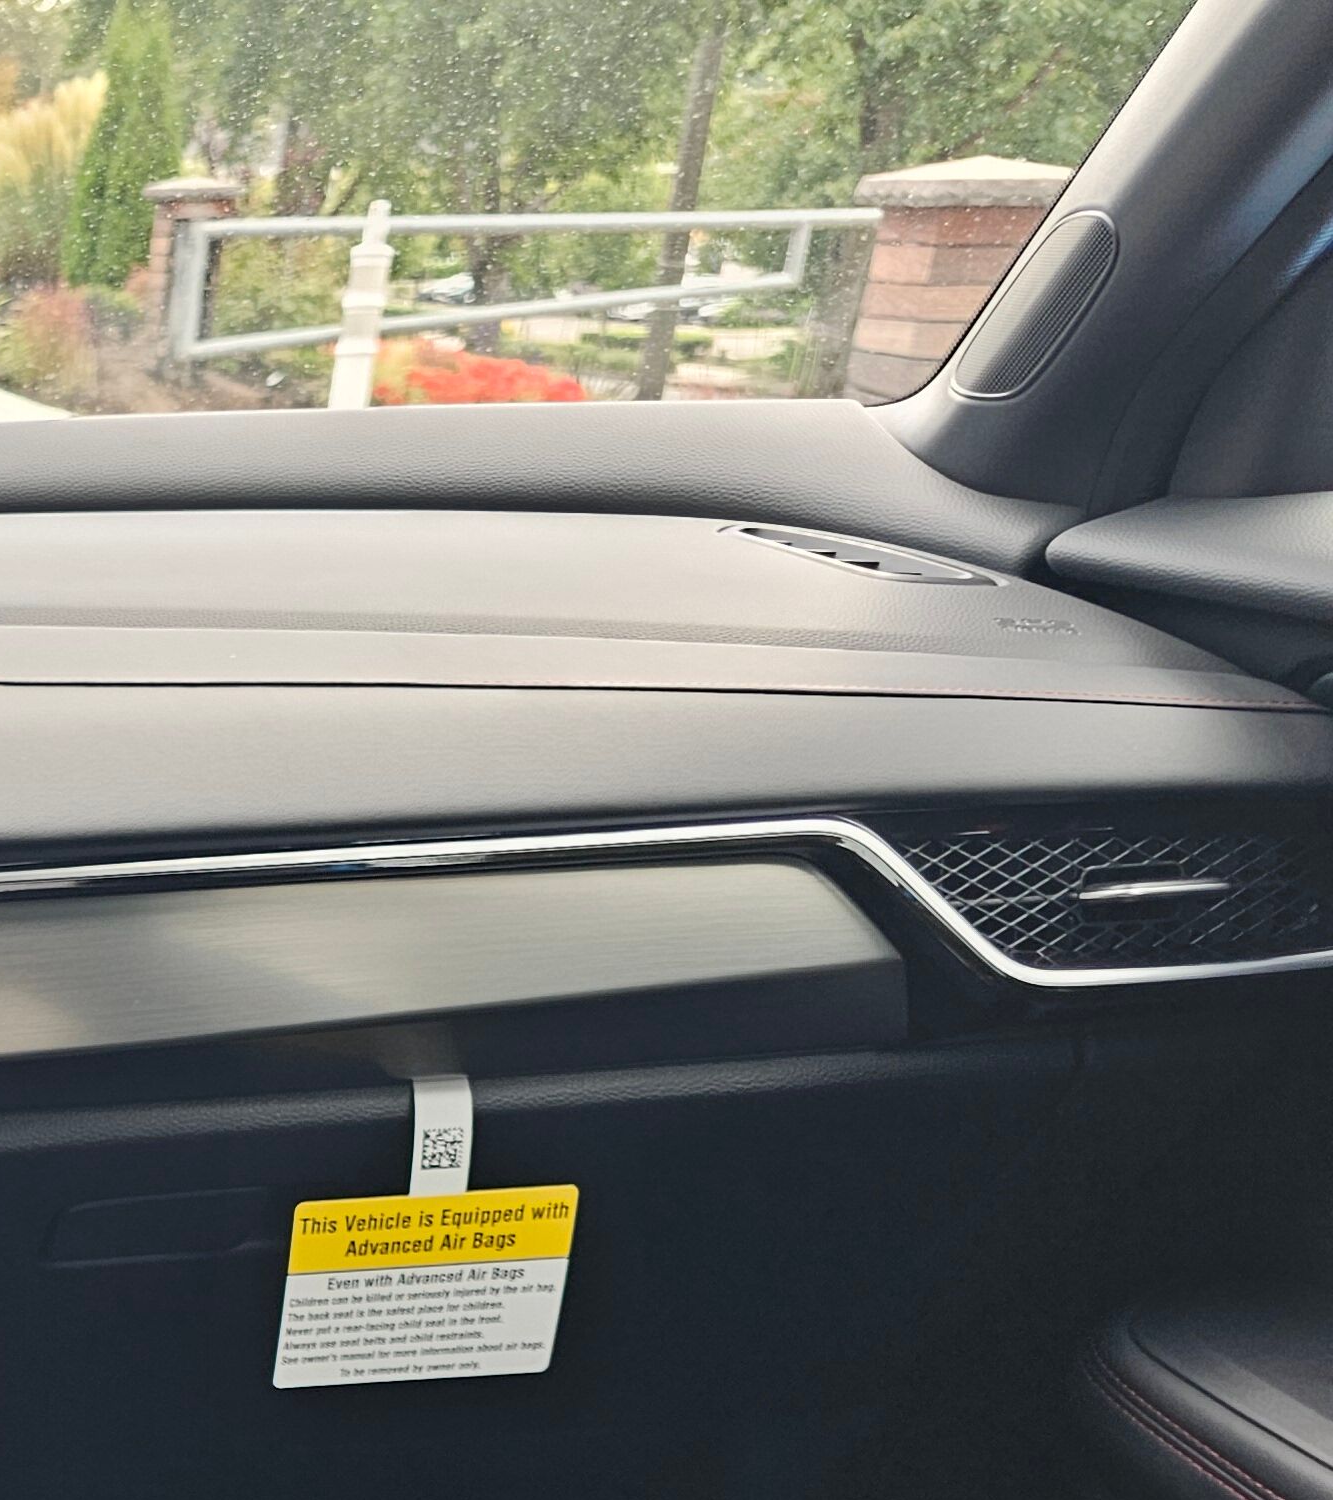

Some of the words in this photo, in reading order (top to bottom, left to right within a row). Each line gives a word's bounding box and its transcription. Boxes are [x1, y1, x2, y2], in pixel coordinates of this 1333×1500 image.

[300, 1217, 337, 1235] This
[345, 1212, 411, 1232] Vehicle
[419, 1210, 434, 1228] is
[441, 1204, 525, 1229] Equipped
[531, 1201, 569, 1220] with
[345, 1235, 434, 1257] Advanced
[440, 1233, 466, 1251] Air
[473, 1231, 516, 1252] Bags
[328, 1277, 359, 1290] Even
[365, 1274, 393, 1287] with
[397, 1270, 463, 1285] Advanced
[467, 1268, 488, 1281] Air
[491, 1267, 525, 1280] Bags
